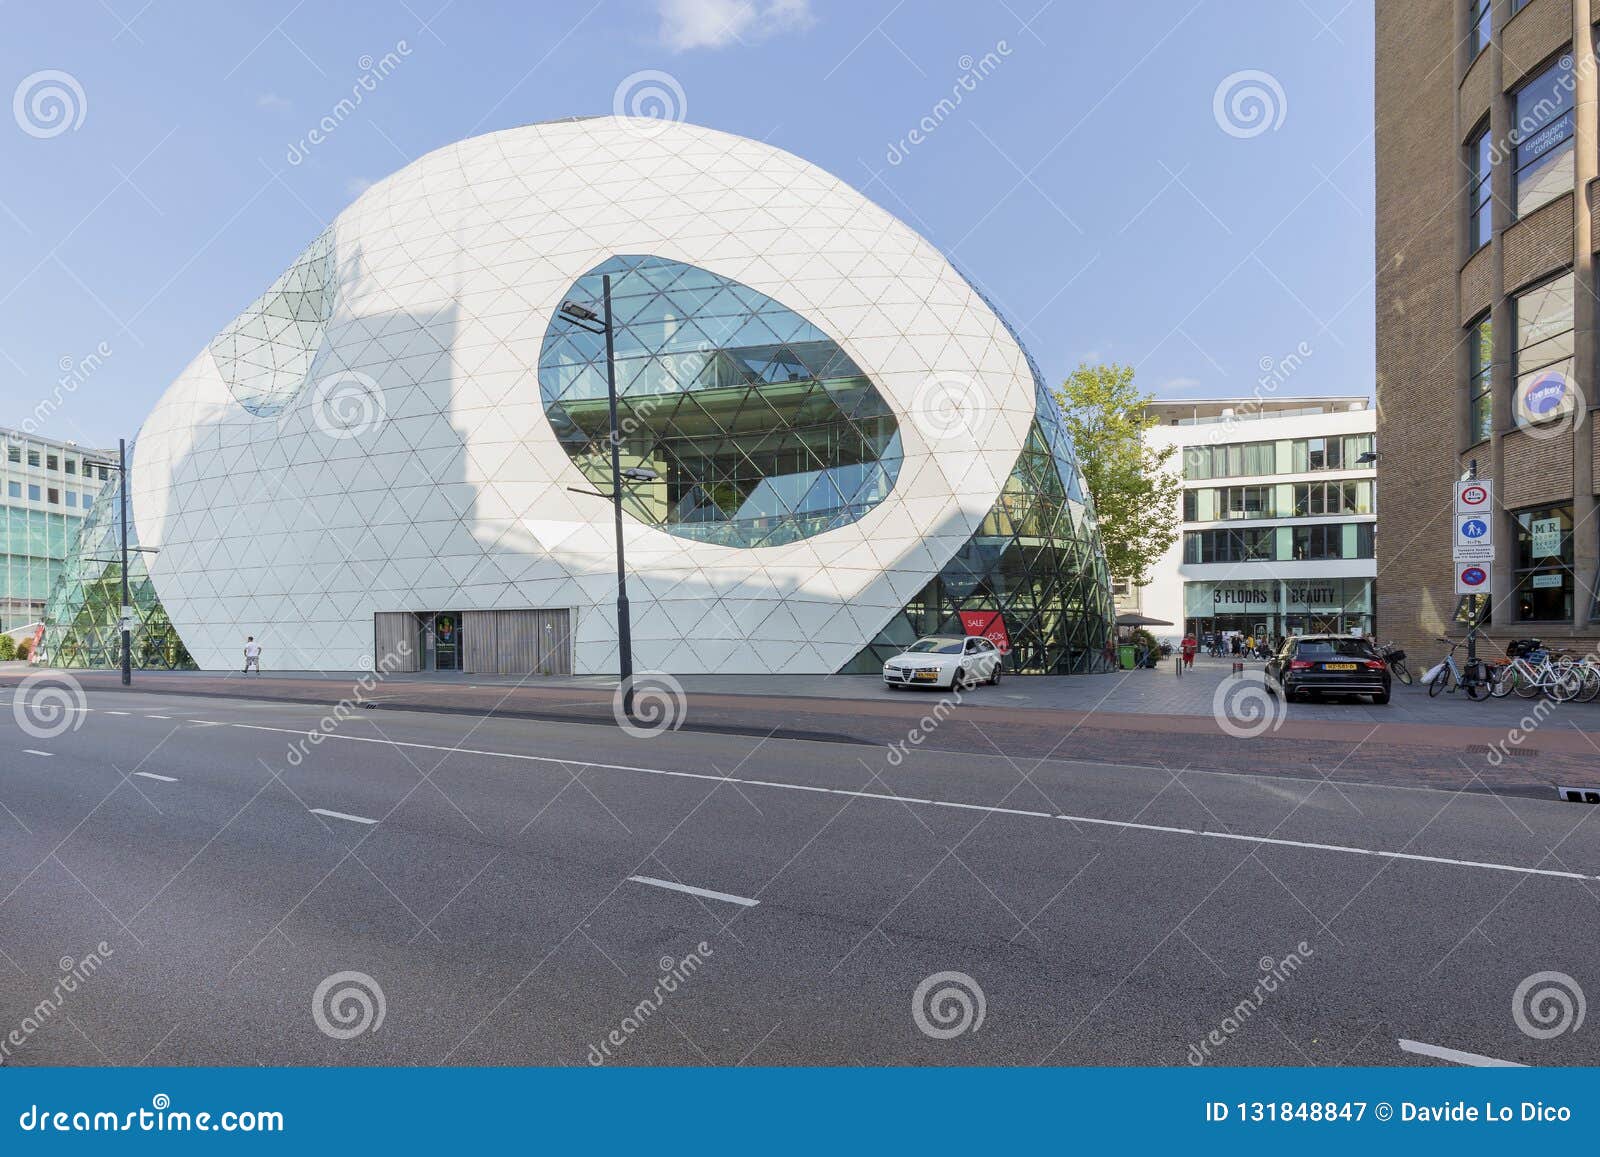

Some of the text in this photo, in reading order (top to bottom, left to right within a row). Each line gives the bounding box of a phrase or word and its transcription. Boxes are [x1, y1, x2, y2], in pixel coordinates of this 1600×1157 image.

[1215, 590, 1221, 603] 3
[1225, 590, 1267, 603] FLOORS
[1292, 588, 1335, 603] BEAUTY
[967, 619, 985, 627] SALE
